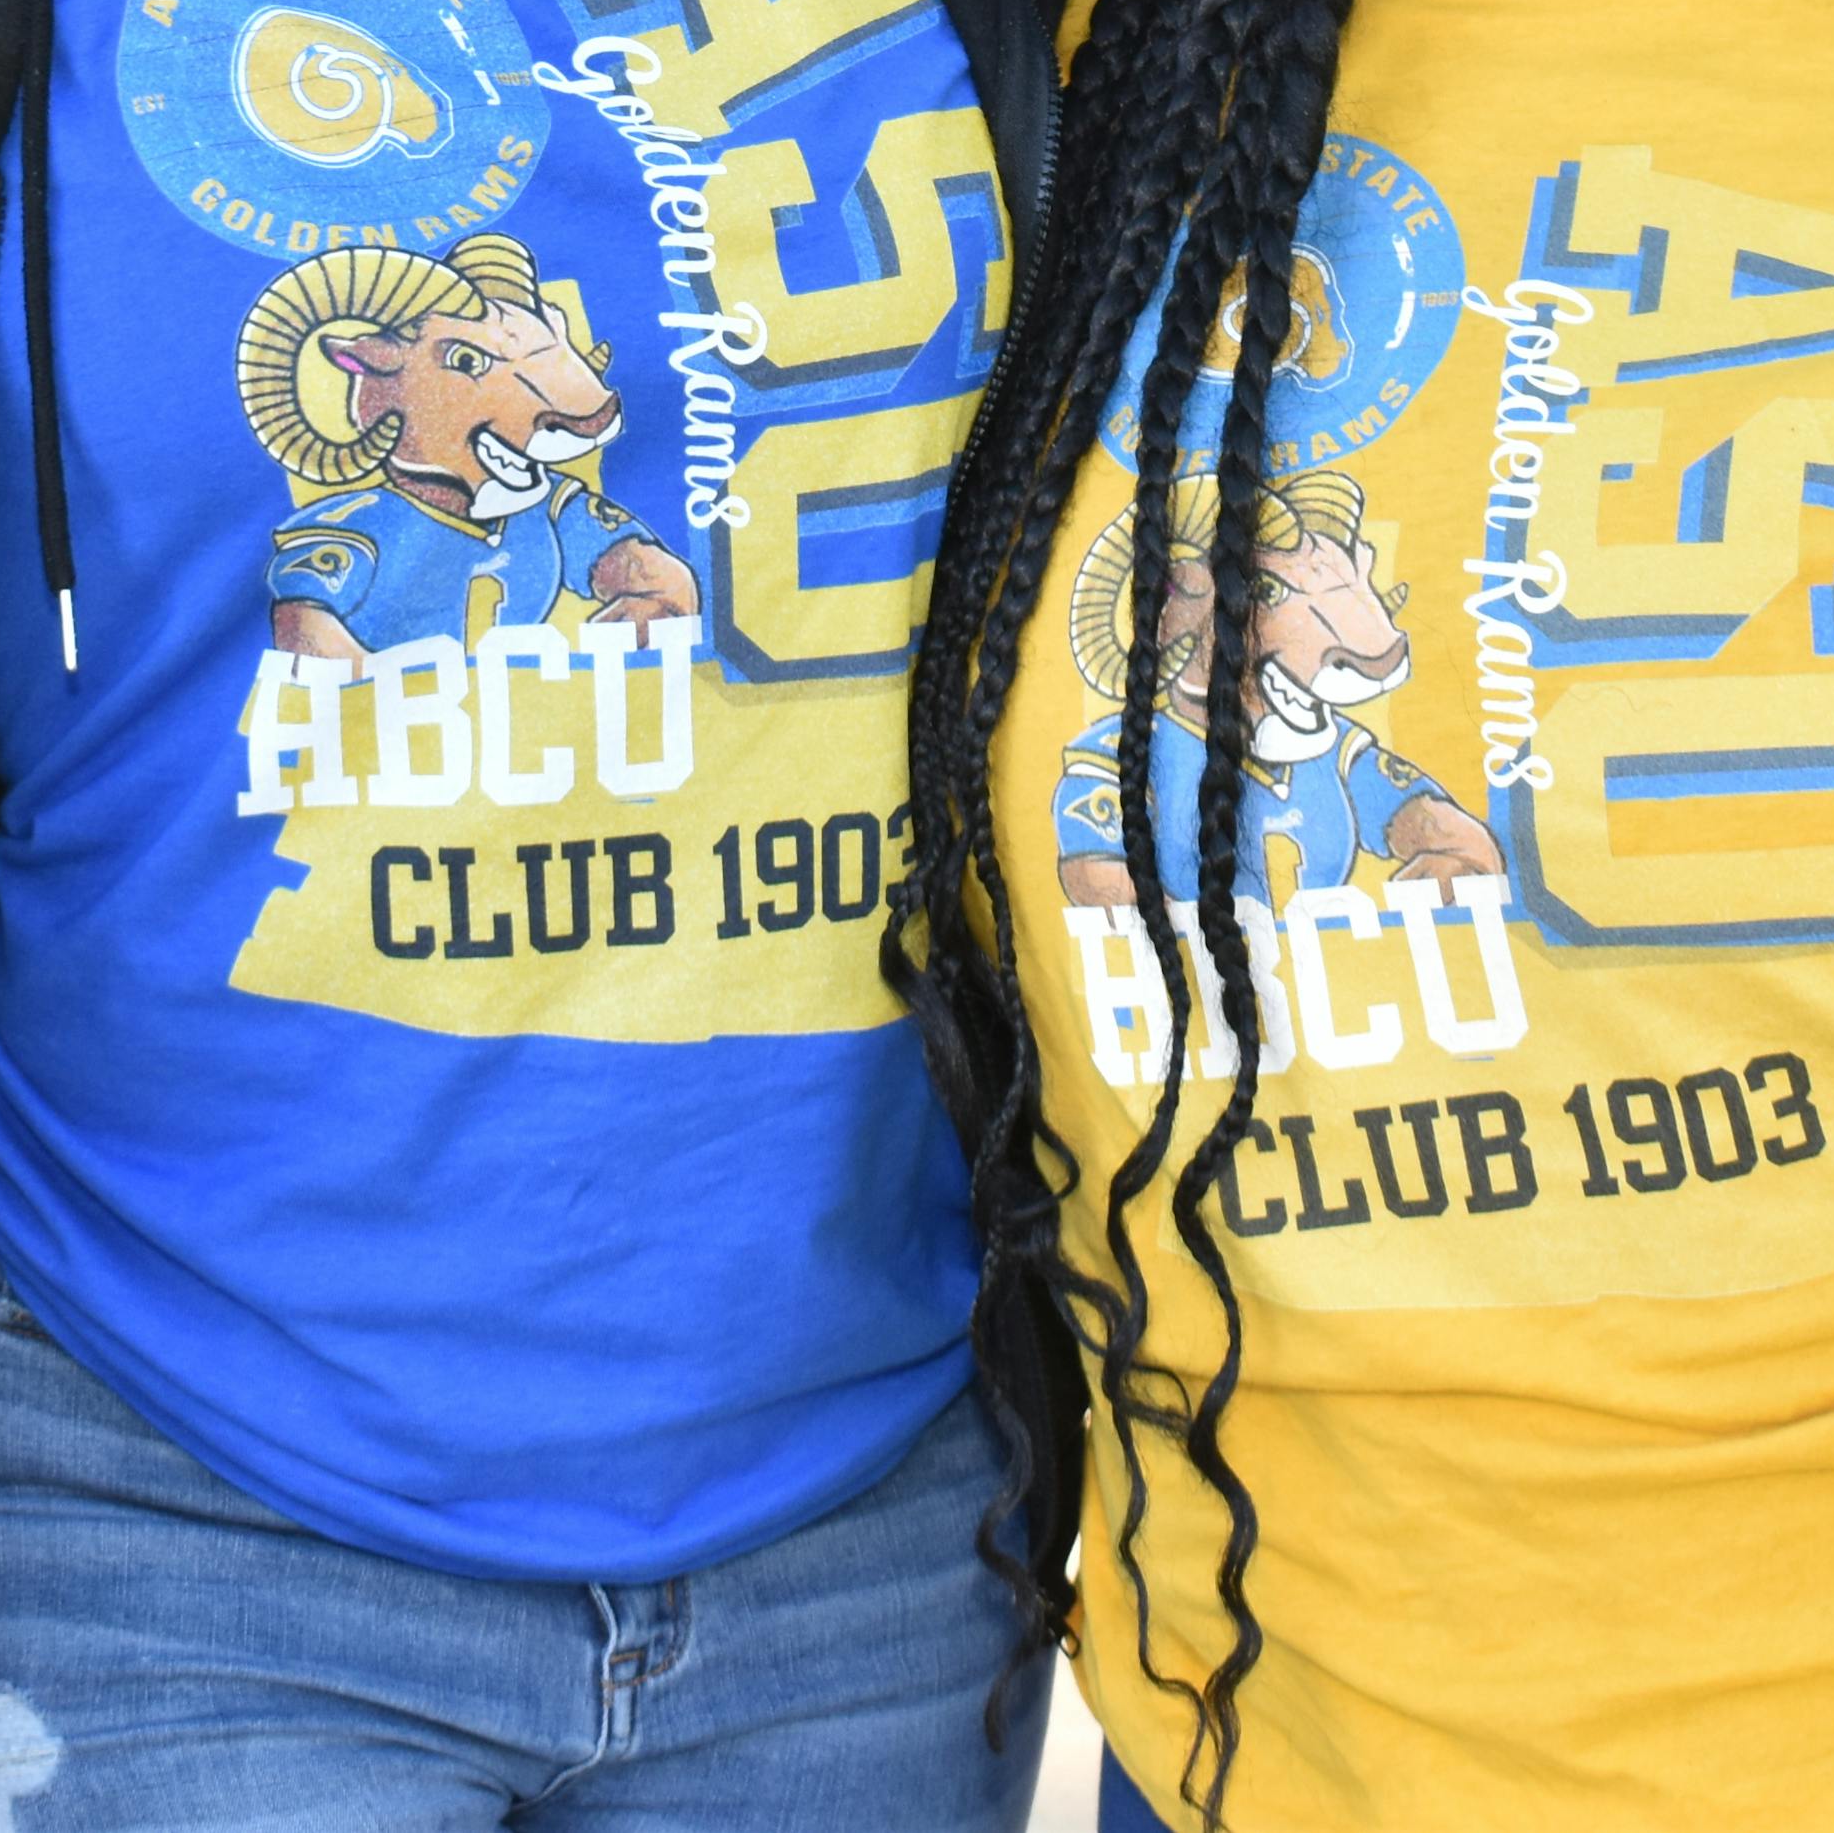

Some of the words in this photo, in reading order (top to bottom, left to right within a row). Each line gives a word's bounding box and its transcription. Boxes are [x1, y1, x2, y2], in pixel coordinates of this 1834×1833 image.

[131, 94, 166, 116] EST
[412, 134, 534, 242] RAMS
[1320, 142, 1442, 237] STATE
[532, 35, 729, 290] Golden
[658, 300, 768, 530] Rams
[1270, 377, 1412, 473] RAMS
[1462, 278, 1594, 542] Golden
[237, 615, 703, 817] HBCU
[1463, 548, 1568, 792] Rams
[370, 832, 675, 960] CLUB
[1061, 873, 1530, 1087] HBCU
[1216, 1090, 1539, 1238] CLUB
[1563, 1051, 1827, 1199] 1903
